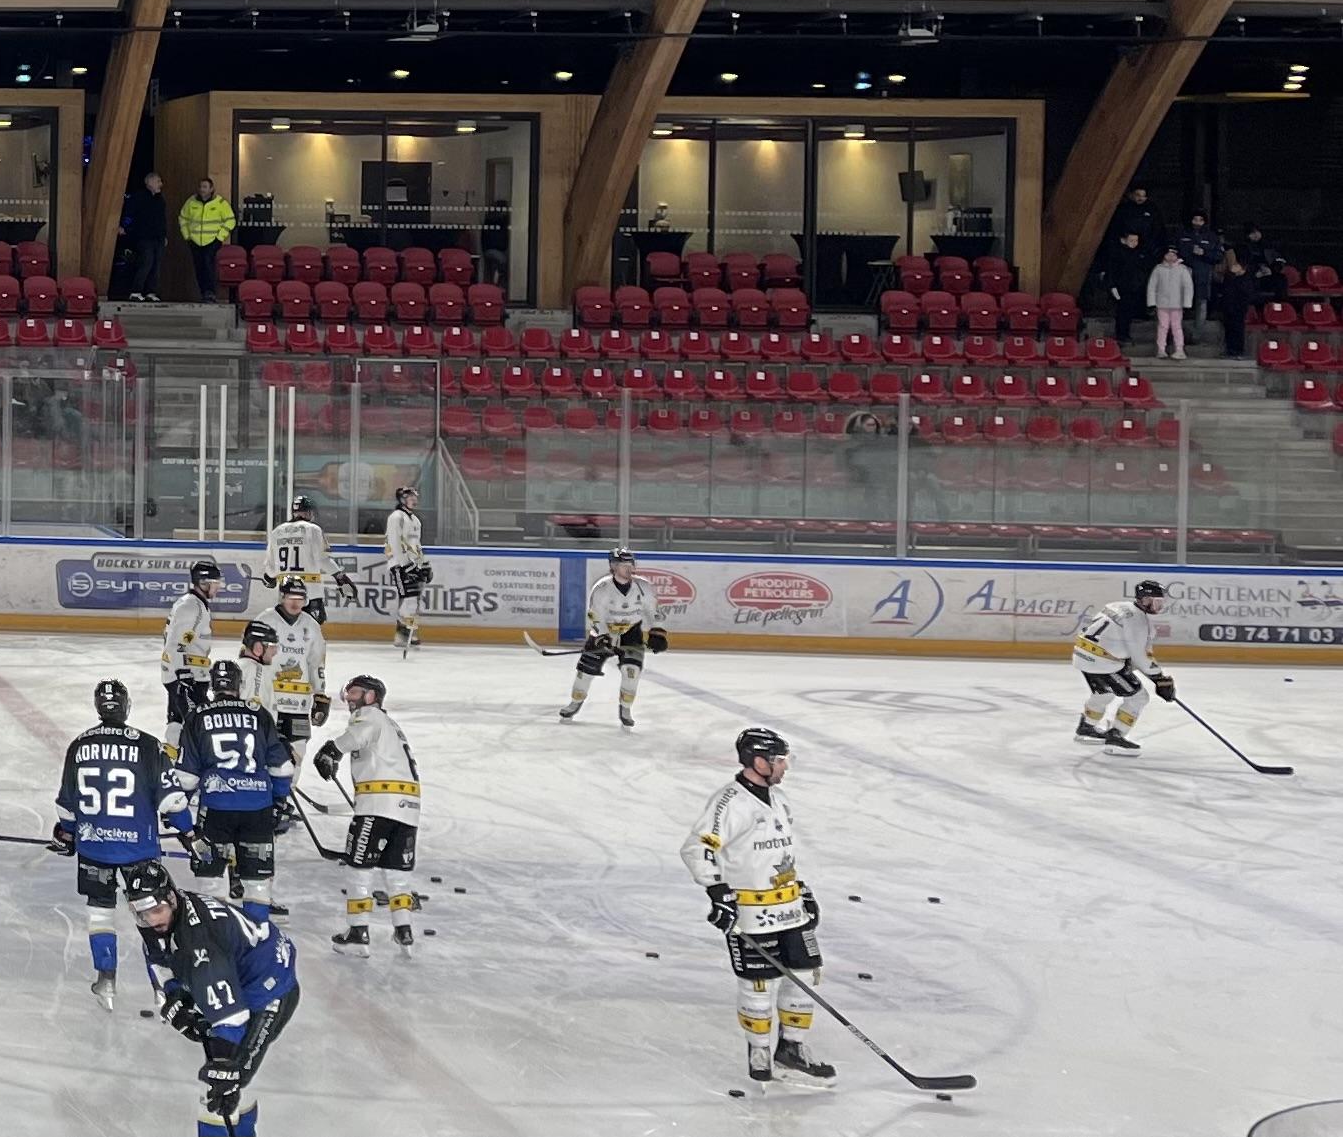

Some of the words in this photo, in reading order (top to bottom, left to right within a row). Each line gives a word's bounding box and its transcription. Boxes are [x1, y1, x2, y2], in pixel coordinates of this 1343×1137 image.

[97, 559, 144, 569] HOCKEY
[147, 559, 171, 569] SUR
[279, 546, 304, 572] 91
[484, 570, 548, 578] CONSTRUCTION
[750, 577, 808, 589] PRODUITS
[493, 582, 534, 590] OSSATURE
[744, 587, 814, 599] PETROLIERS
[1168, 581, 1292, 602] GENTLEMEN
[1212, 625, 1236, 640] 09
[1244, 627, 1269, 641] 74
[1277, 628, 1299, 642] 71
[1309, 629, 1334, 643] 03
[212, 733, 256, 773] 51
[77, 767, 135, 817] 52
[207, 980, 235, 1010] 47
